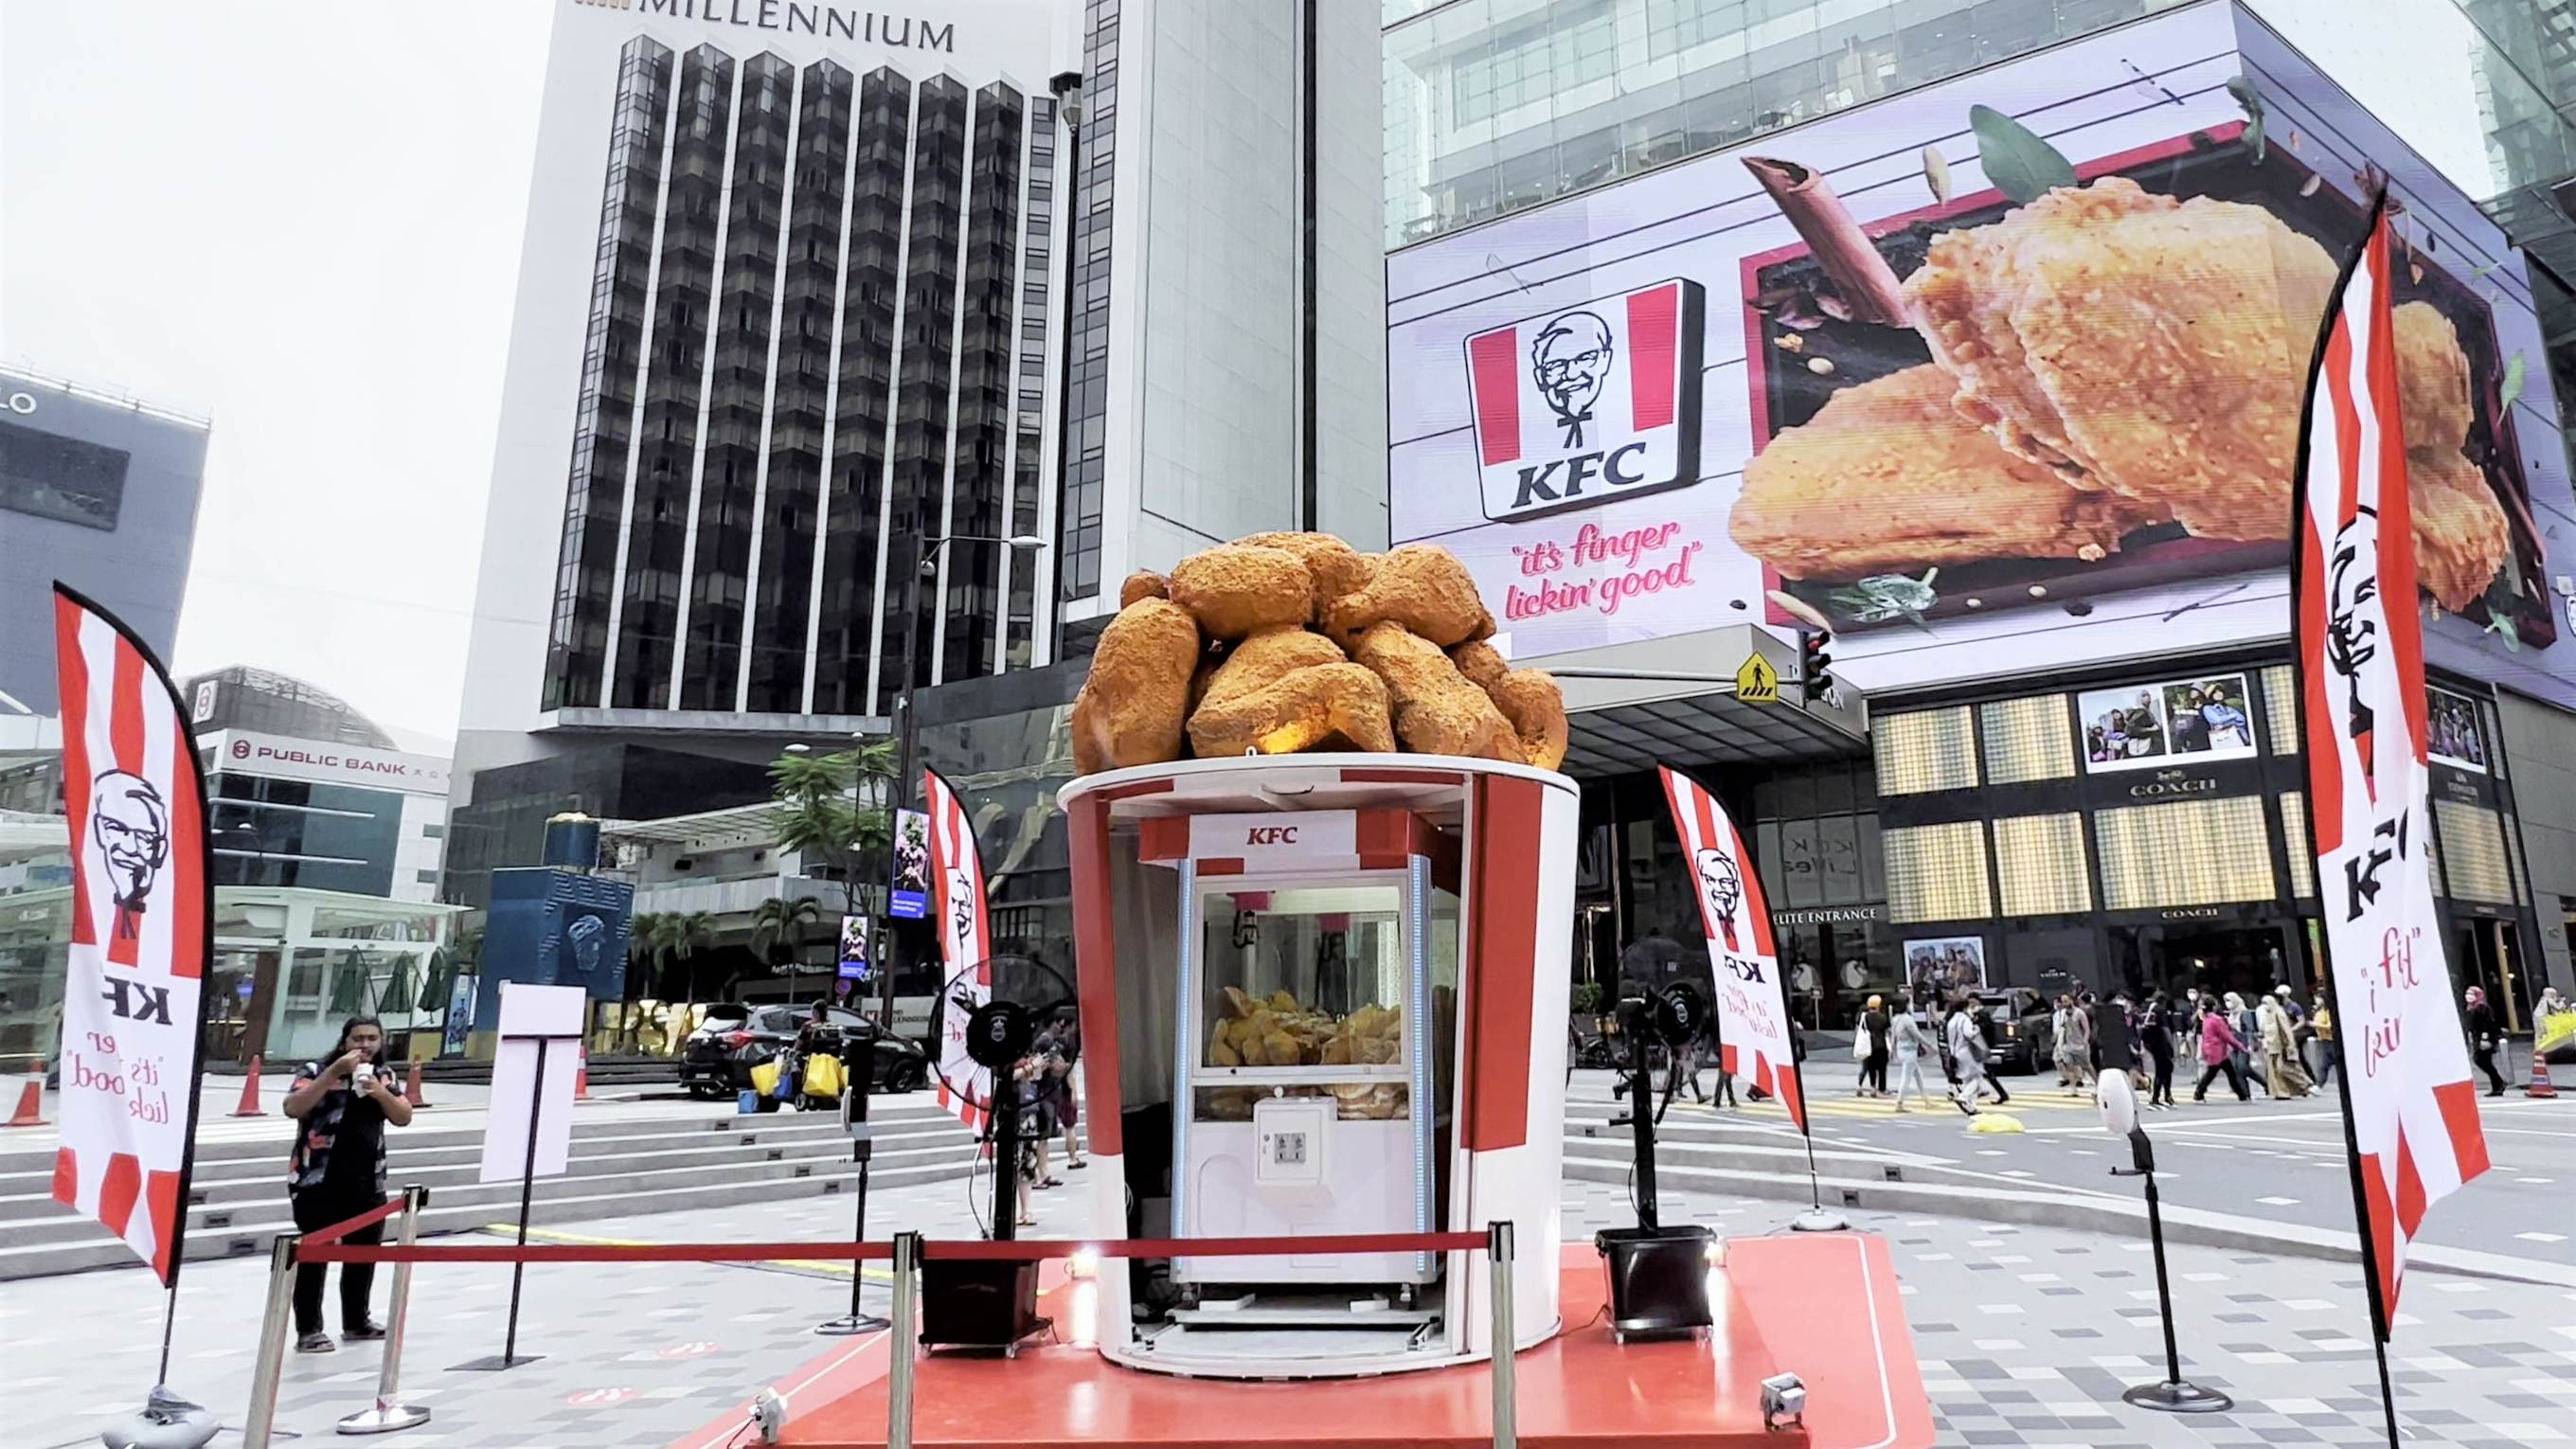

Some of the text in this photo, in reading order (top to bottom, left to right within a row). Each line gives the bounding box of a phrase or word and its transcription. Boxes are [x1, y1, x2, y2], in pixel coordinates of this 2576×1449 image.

[1511, 441, 1646, 510] KFC
[1570, 523, 1680, 568] finger
[1505, 578, 1596, 621] lickin'
[258, 746, 405, 776] PUBLIC BANK
[2130, 778, 2216, 796] COACH
[1246, 826, 1297, 845] KFC
[1772, 908, 1876, 925] ELITE ENTRANCE
[2161, 907, 2218, 919] COACH
